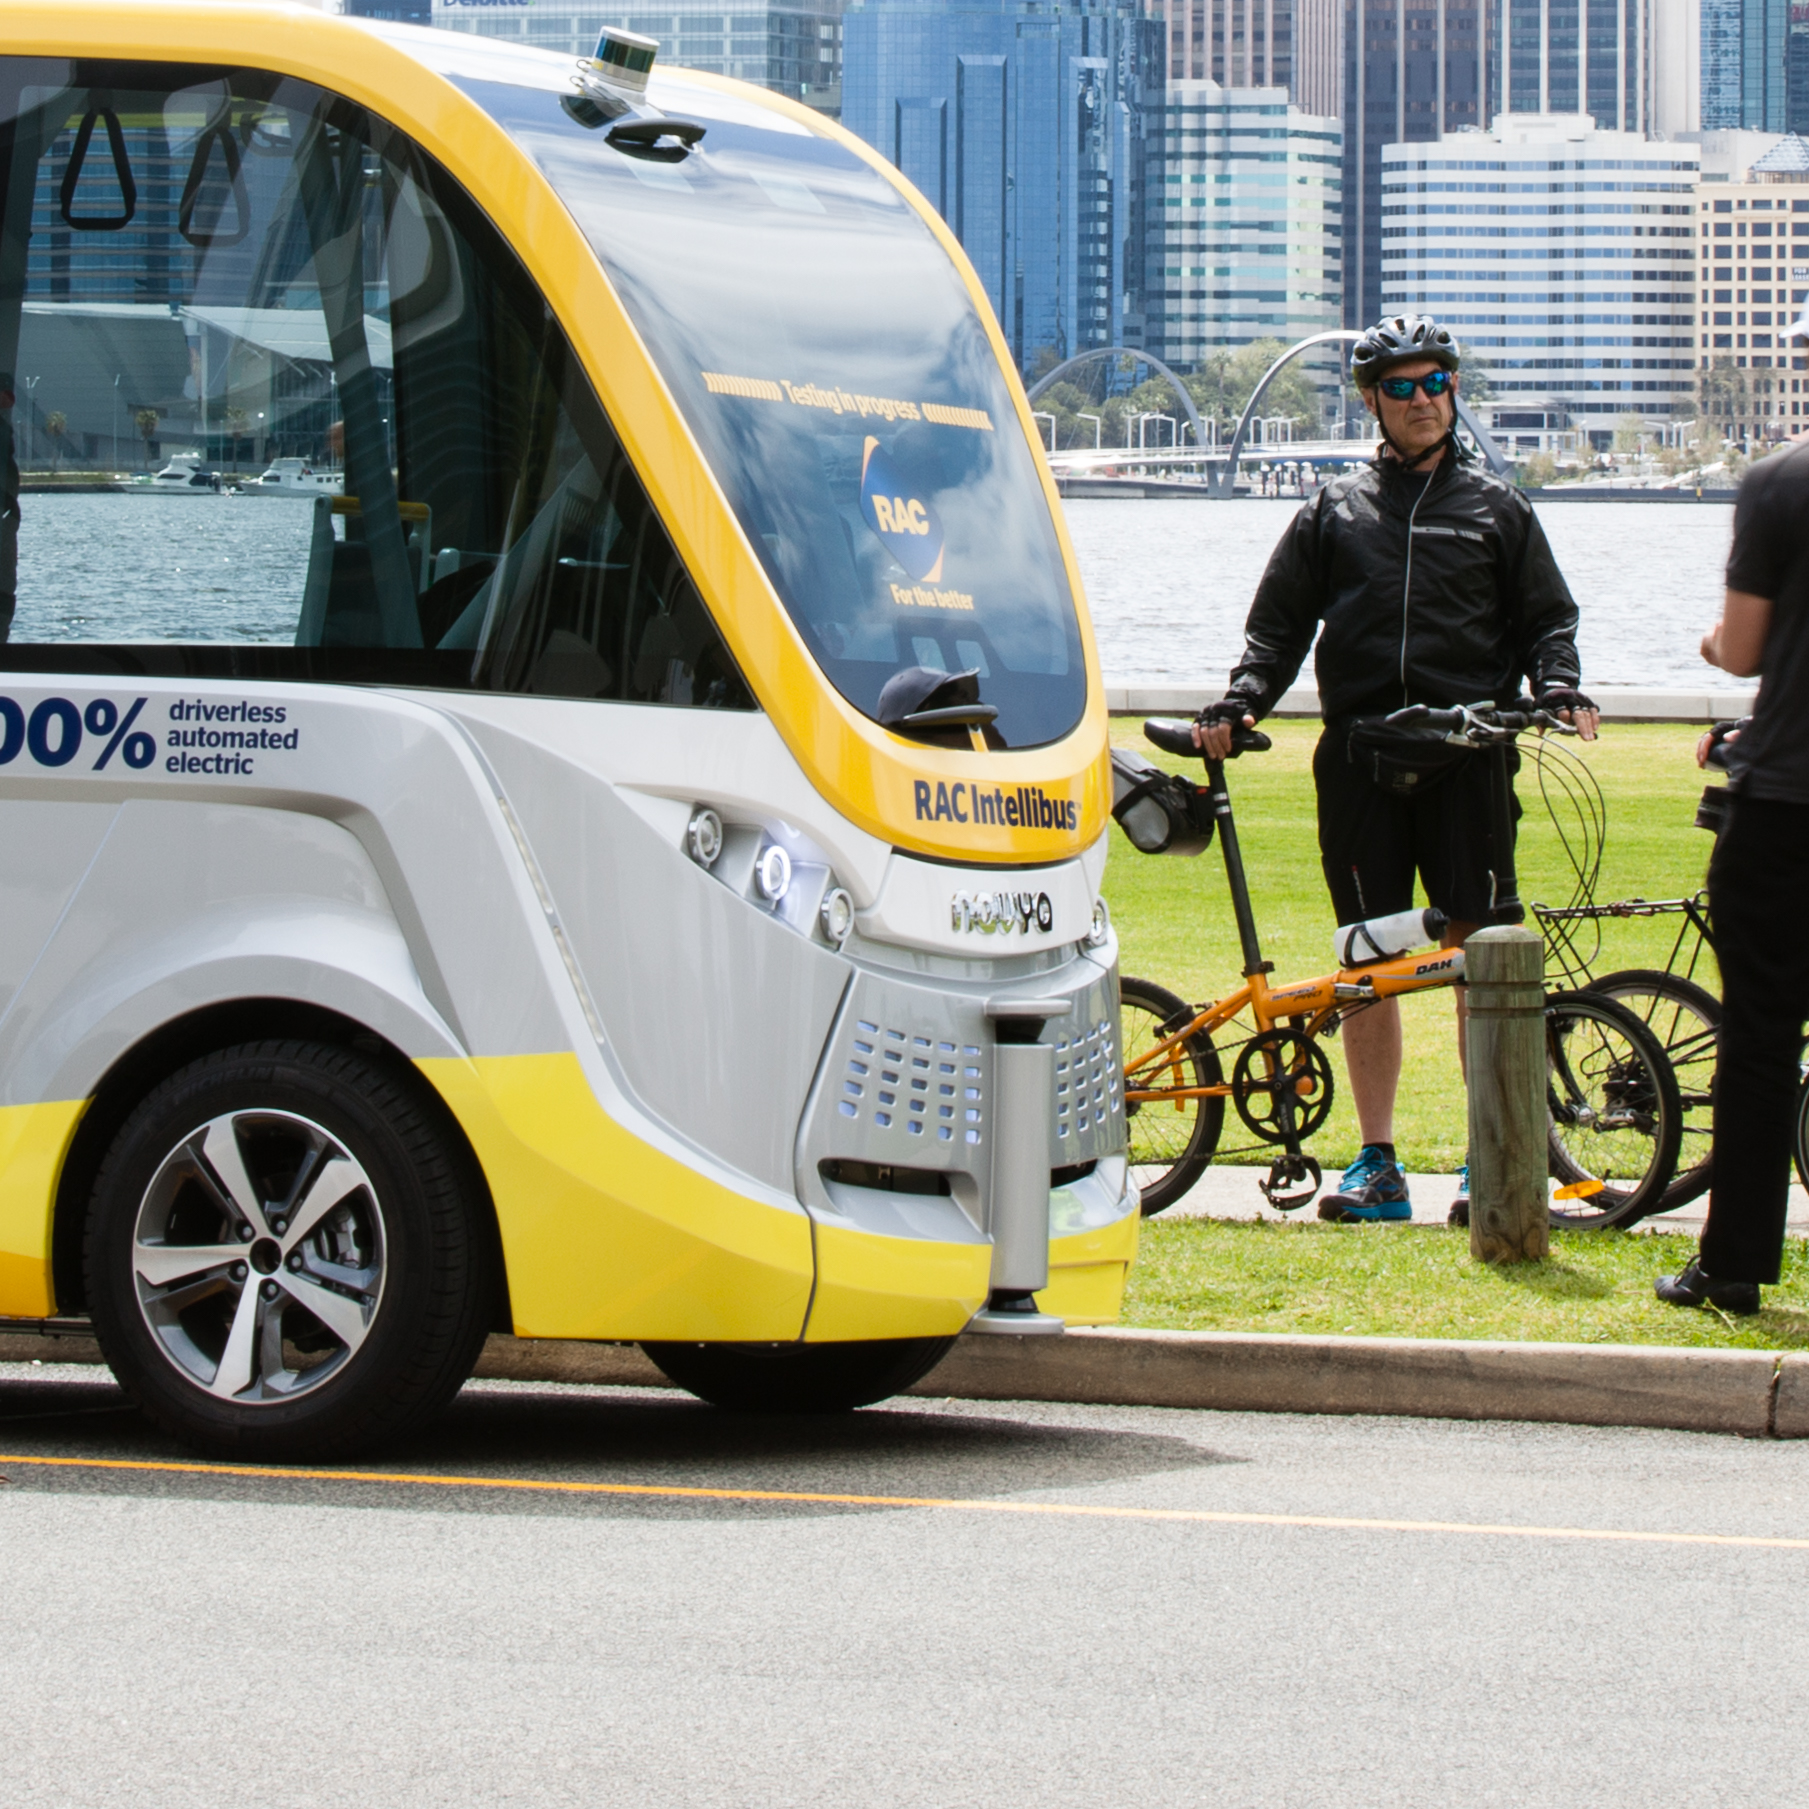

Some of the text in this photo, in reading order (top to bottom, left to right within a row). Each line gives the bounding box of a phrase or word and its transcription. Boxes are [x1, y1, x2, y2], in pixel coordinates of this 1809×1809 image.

[780, 379, 921, 422] Testing in progress
[871, 494, 930, 536] RAC
[890, 584, 974, 610] For the better
[169, 699, 287, 723] driverless
[167, 726, 299, 750] automated
[165, 752, 254, 775] electric
[914, 779, 968, 824] RAC
[1415, 958, 1454, 976] DAH
